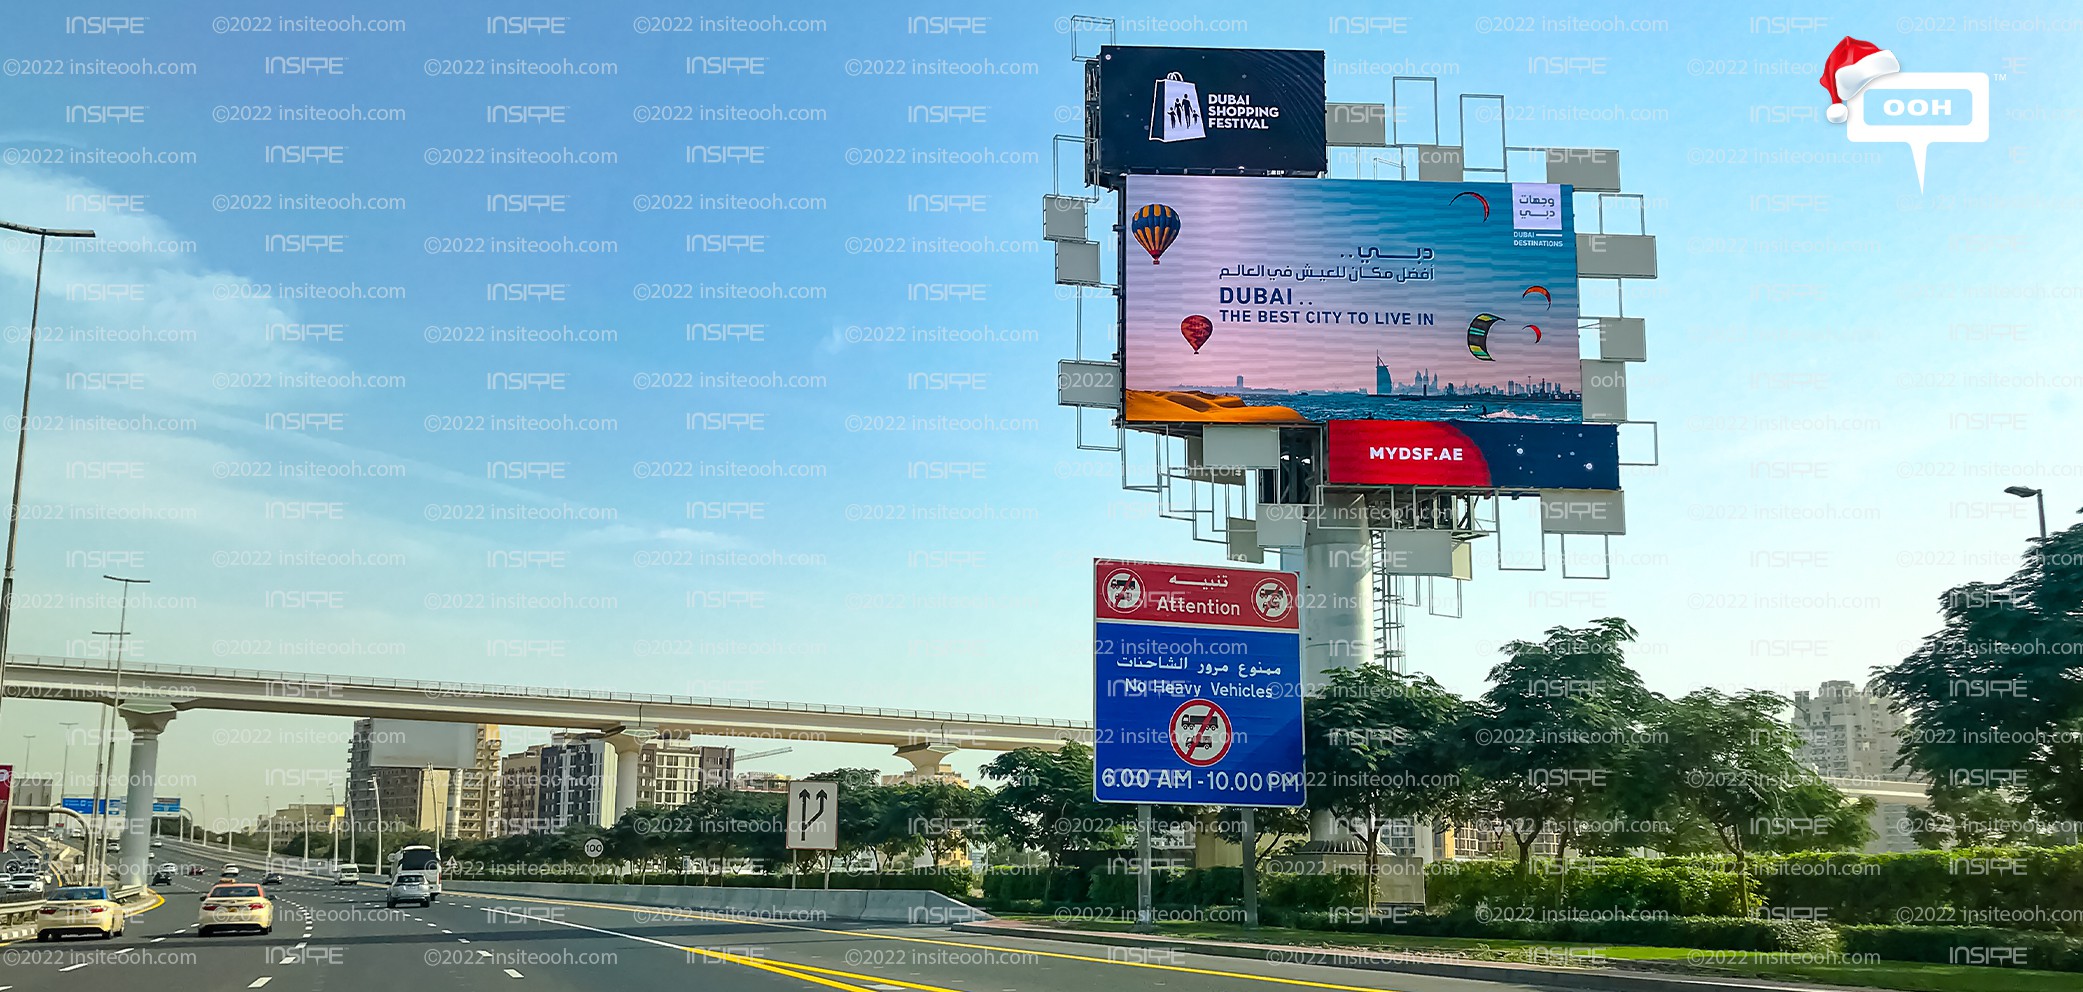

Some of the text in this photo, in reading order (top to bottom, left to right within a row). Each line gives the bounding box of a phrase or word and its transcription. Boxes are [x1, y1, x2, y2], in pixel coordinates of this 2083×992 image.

[1208, 93, 1250, 105] DUBAI
[1208, 106, 1279, 118] SHOPPING
[1208, 118, 1269, 129] FESTIVAL
[1519, 195, 1555, 207] وجهات
[1519, 209, 1555, 220] دبي
[1513, 239, 1563, 247] DESTINATIONS
[1218, 263, 1435, 283] أفضل مكان للعيش في العالم
[1219, 309, 1434, 326] THE BEST CITY TO LIVE IN
[1369, 446, 1463, 461] MYDSF.AE
[1168, 574, 1229, 590] تنبيه
[1156, 596, 1240, 616] Attention
[1116, 656, 1281, 678] ممنوع مرور الشاحنات
[1125, 678, 1273, 699] No Heavy Vehicles
[1101, 768, 1149, 788] 6.00
[1156, 769, 1192, 789] AM
[1268, 773, 1299, 793] PM
[585, 844, 602, 853] 100
